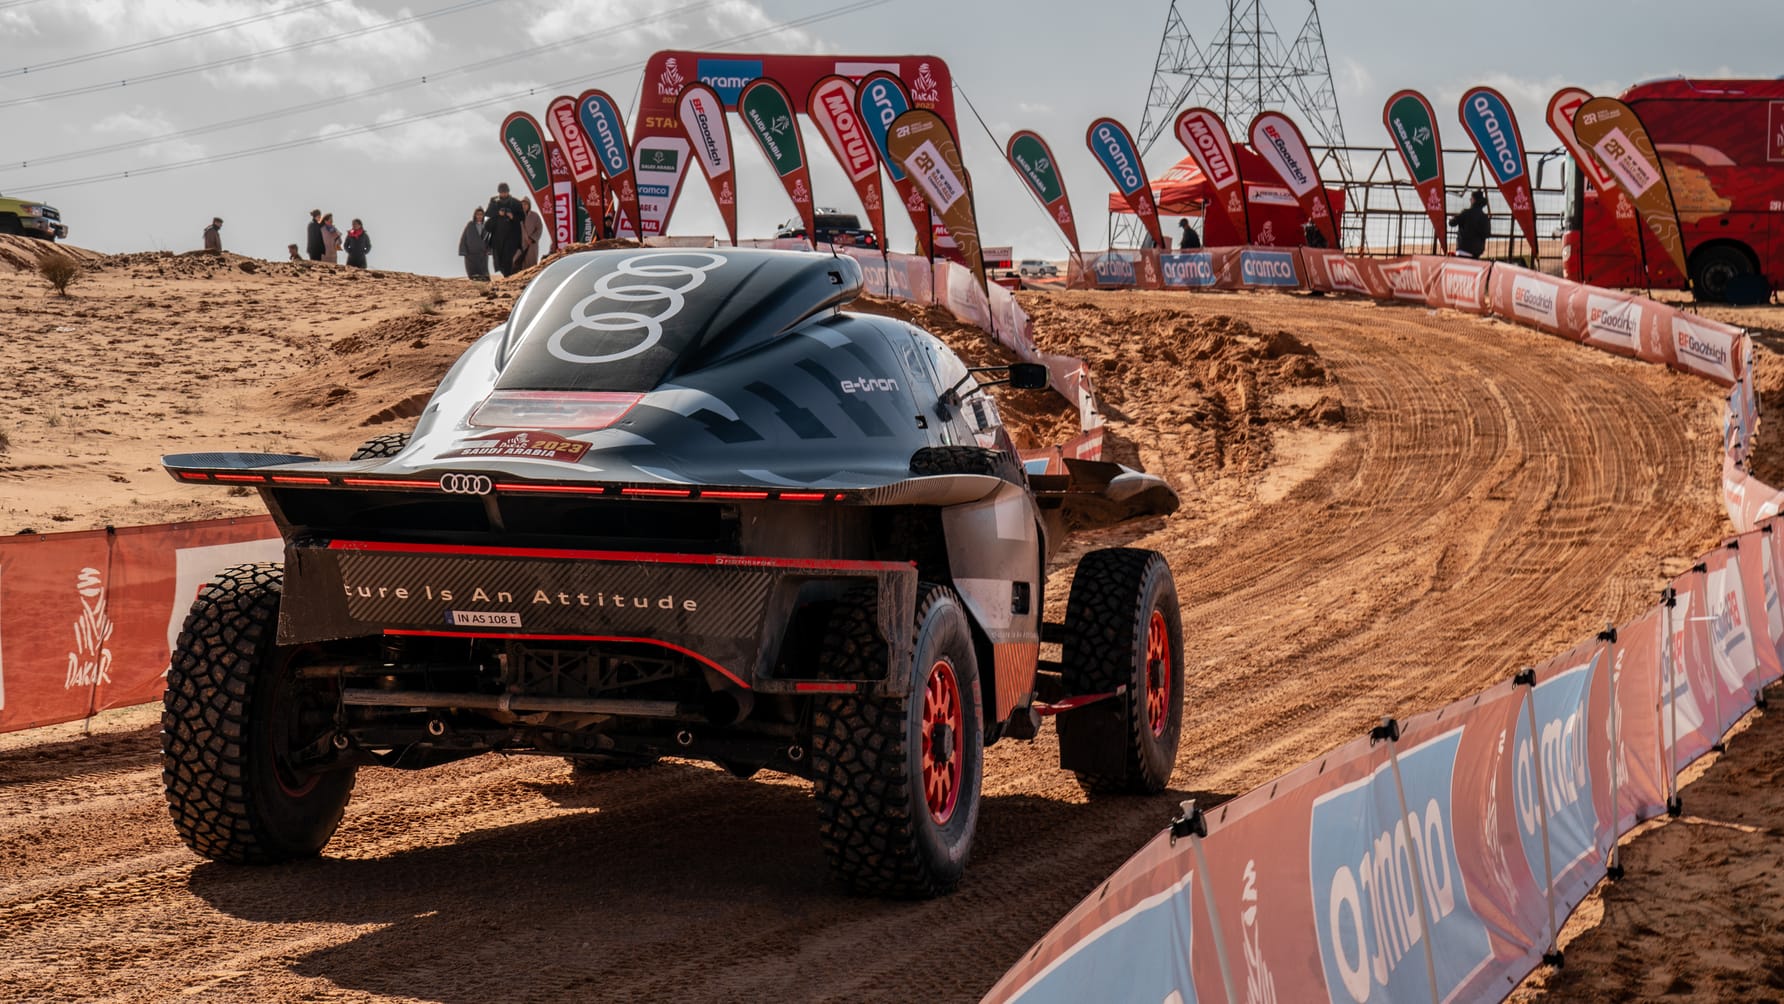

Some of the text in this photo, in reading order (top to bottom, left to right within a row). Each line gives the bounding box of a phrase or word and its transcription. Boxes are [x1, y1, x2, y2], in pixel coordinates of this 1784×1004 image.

[700, 76, 754, 88] aramc
[871, 84, 897, 131] ara
[911, 88, 940, 103] DAKAR
[588, 100, 623, 169] aramco
[645, 116, 678, 129] STA
[691, 97, 721, 167] BFGoodrich
[749, 108, 783, 161] SAUDI ARABIA
[825, 95, 870, 170] MOTUL
[1474, 96, 1517, 174] aramco
[556, 109, 589, 172] MOTUL
[1187, 120, 1230, 180] MOTUL
[1098, 127, 1138, 188] aramco
[1264, 124, 1308, 185] BFGoodrich
[638, 186, 667, 195] ramco
[622, 220, 657, 230] MTUL
[1164, 261, 1211, 279] aramco
[1244, 259, 1291, 279] aramco
[1515, 287, 1553, 311] BFGoodrich
[840, 376, 900, 394] e-tron
[461, 448, 556, 457] SAUDI ARABIA
[530, 440, 584, 454] 2023
[425, 585, 454, 601] Is
[471, 587, 513, 603] An
[532, 589, 697, 611] Attitude
[457, 613, 517, 625] IN AS 108 E
[63, 648, 113, 690] DAKAR
